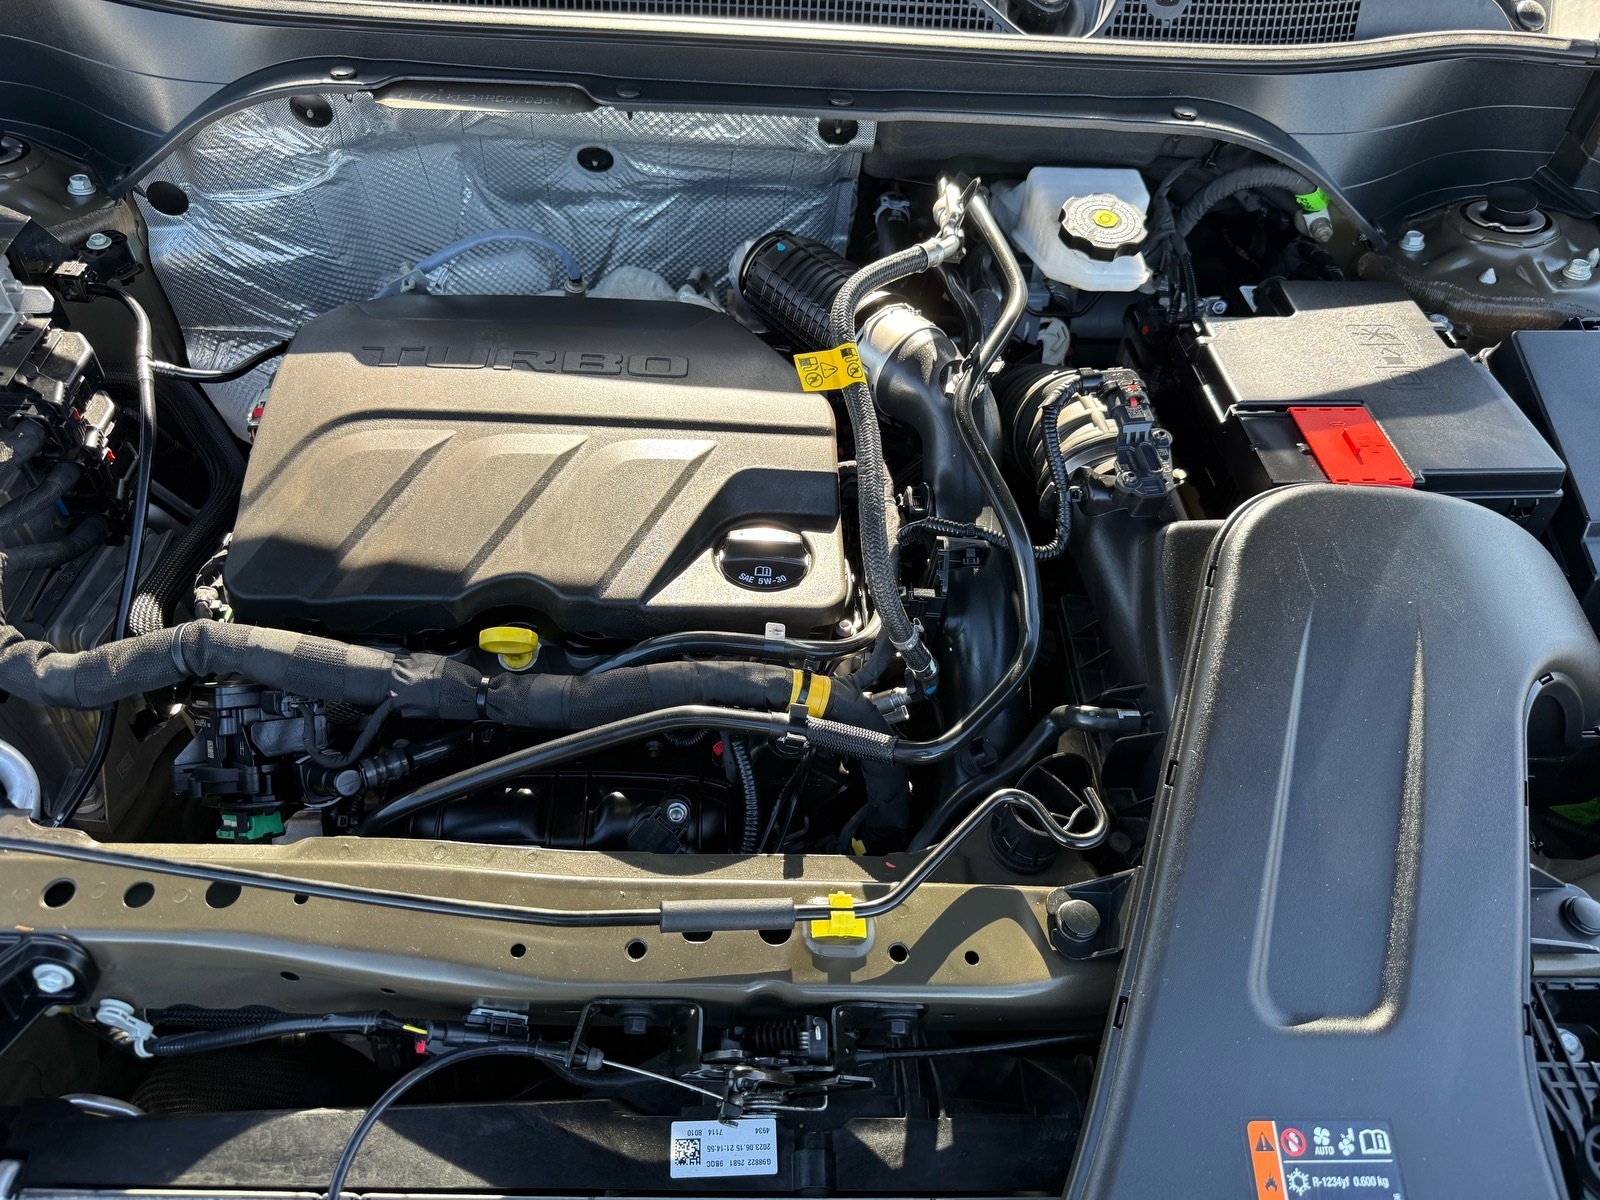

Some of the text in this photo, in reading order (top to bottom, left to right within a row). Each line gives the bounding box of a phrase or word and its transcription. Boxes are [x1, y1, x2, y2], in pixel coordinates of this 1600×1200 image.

[362, 345, 689, 378] TURBO
[738, 572, 787, 585] SAE 5W-30
[687, 1129, 703, 1137] 8010
[708, 1128, 724, 1136] 7114
[706, 1143, 771, 1153] 2023.06.15 21:14:55
[1314, 1145, 1335, 1156] AUTO
[1312, 1175, 1390, 1189] R-1234yf 0.600 kg
